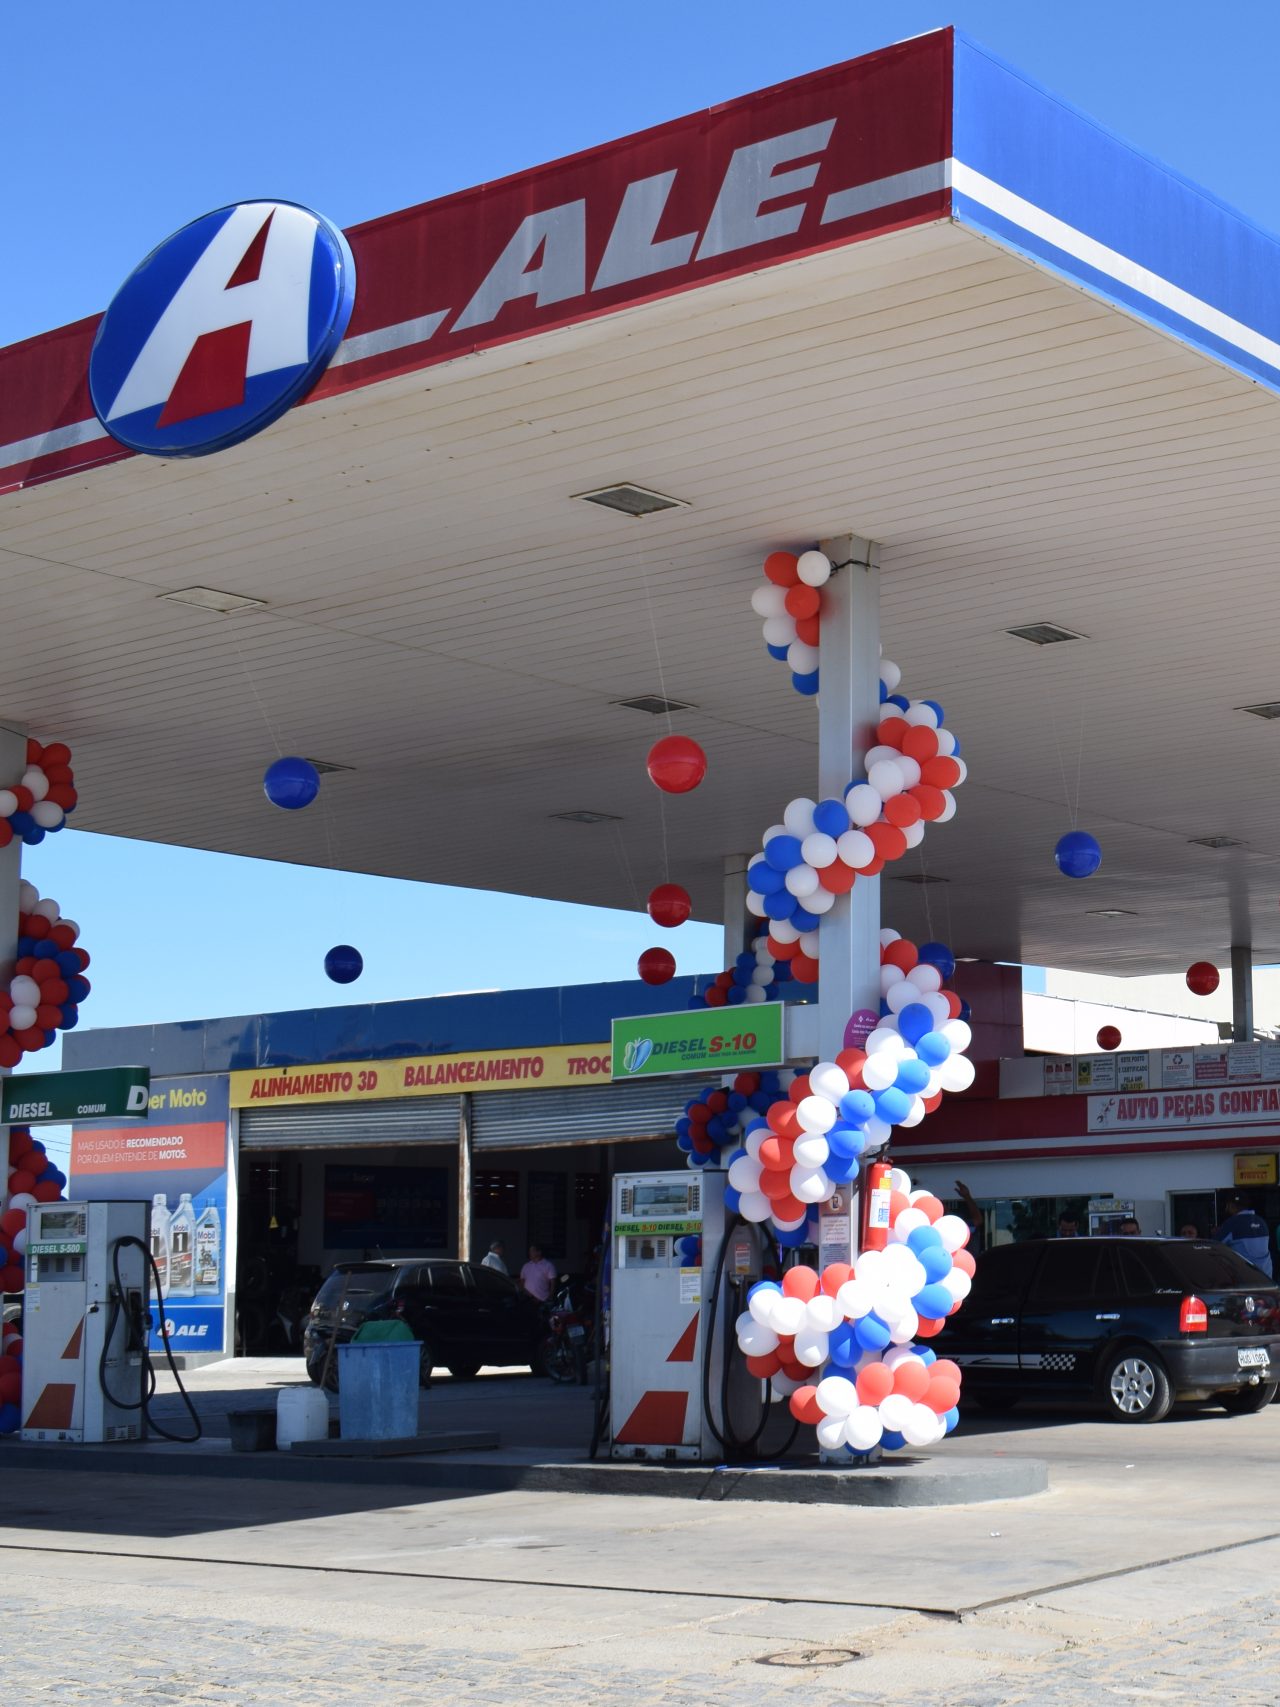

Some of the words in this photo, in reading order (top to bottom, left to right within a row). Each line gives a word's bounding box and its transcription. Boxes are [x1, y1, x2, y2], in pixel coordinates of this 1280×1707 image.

[451, 118, 837, 334] ALE
[651, 1037, 707, 1056] DIESEL
[708, 1032, 757, 1054] S-10
[681, 1051, 707, 1061] COMUM
[250, 1071, 353, 1099] ALINHAMENTO
[357, 1071, 378, 1092] 3D
[404, 1056, 544, 1087] BALANCEAMENTO
[148, 1094, 167, 1110] er
[169, 1088, 206, 1108] Moto
[9, 1102, 53, 1119] DIESEL
[77, 1103, 107, 1115] COMUM
[1116, 1096, 1159, 1121] AUTO
[1162, 1092, 1216, 1123] PEÇAS
[78, 1142, 94, 1151] MAIS
[95, 1140, 120, 1150] USADO
[126, 1135, 184, 1148] RECOMENDADO
[77, 1154, 93, 1165] POR
[94, 1152, 115, 1164] QUEM
[116, 1151, 147, 1163] ENTENDE
[149, 1150, 158, 1161] DE
[159, 1149, 188, 1160] MOTOS.
[173, 1224, 189, 1232] Mobil
[197, 1230, 216, 1240] Mobil
[31, 1245, 58, 1254] DIESEL
[59, 1243, 81, 1253] S-500
[177, 1233, 184, 1252] 1
[175, 1325, 208, 1337] ALE
